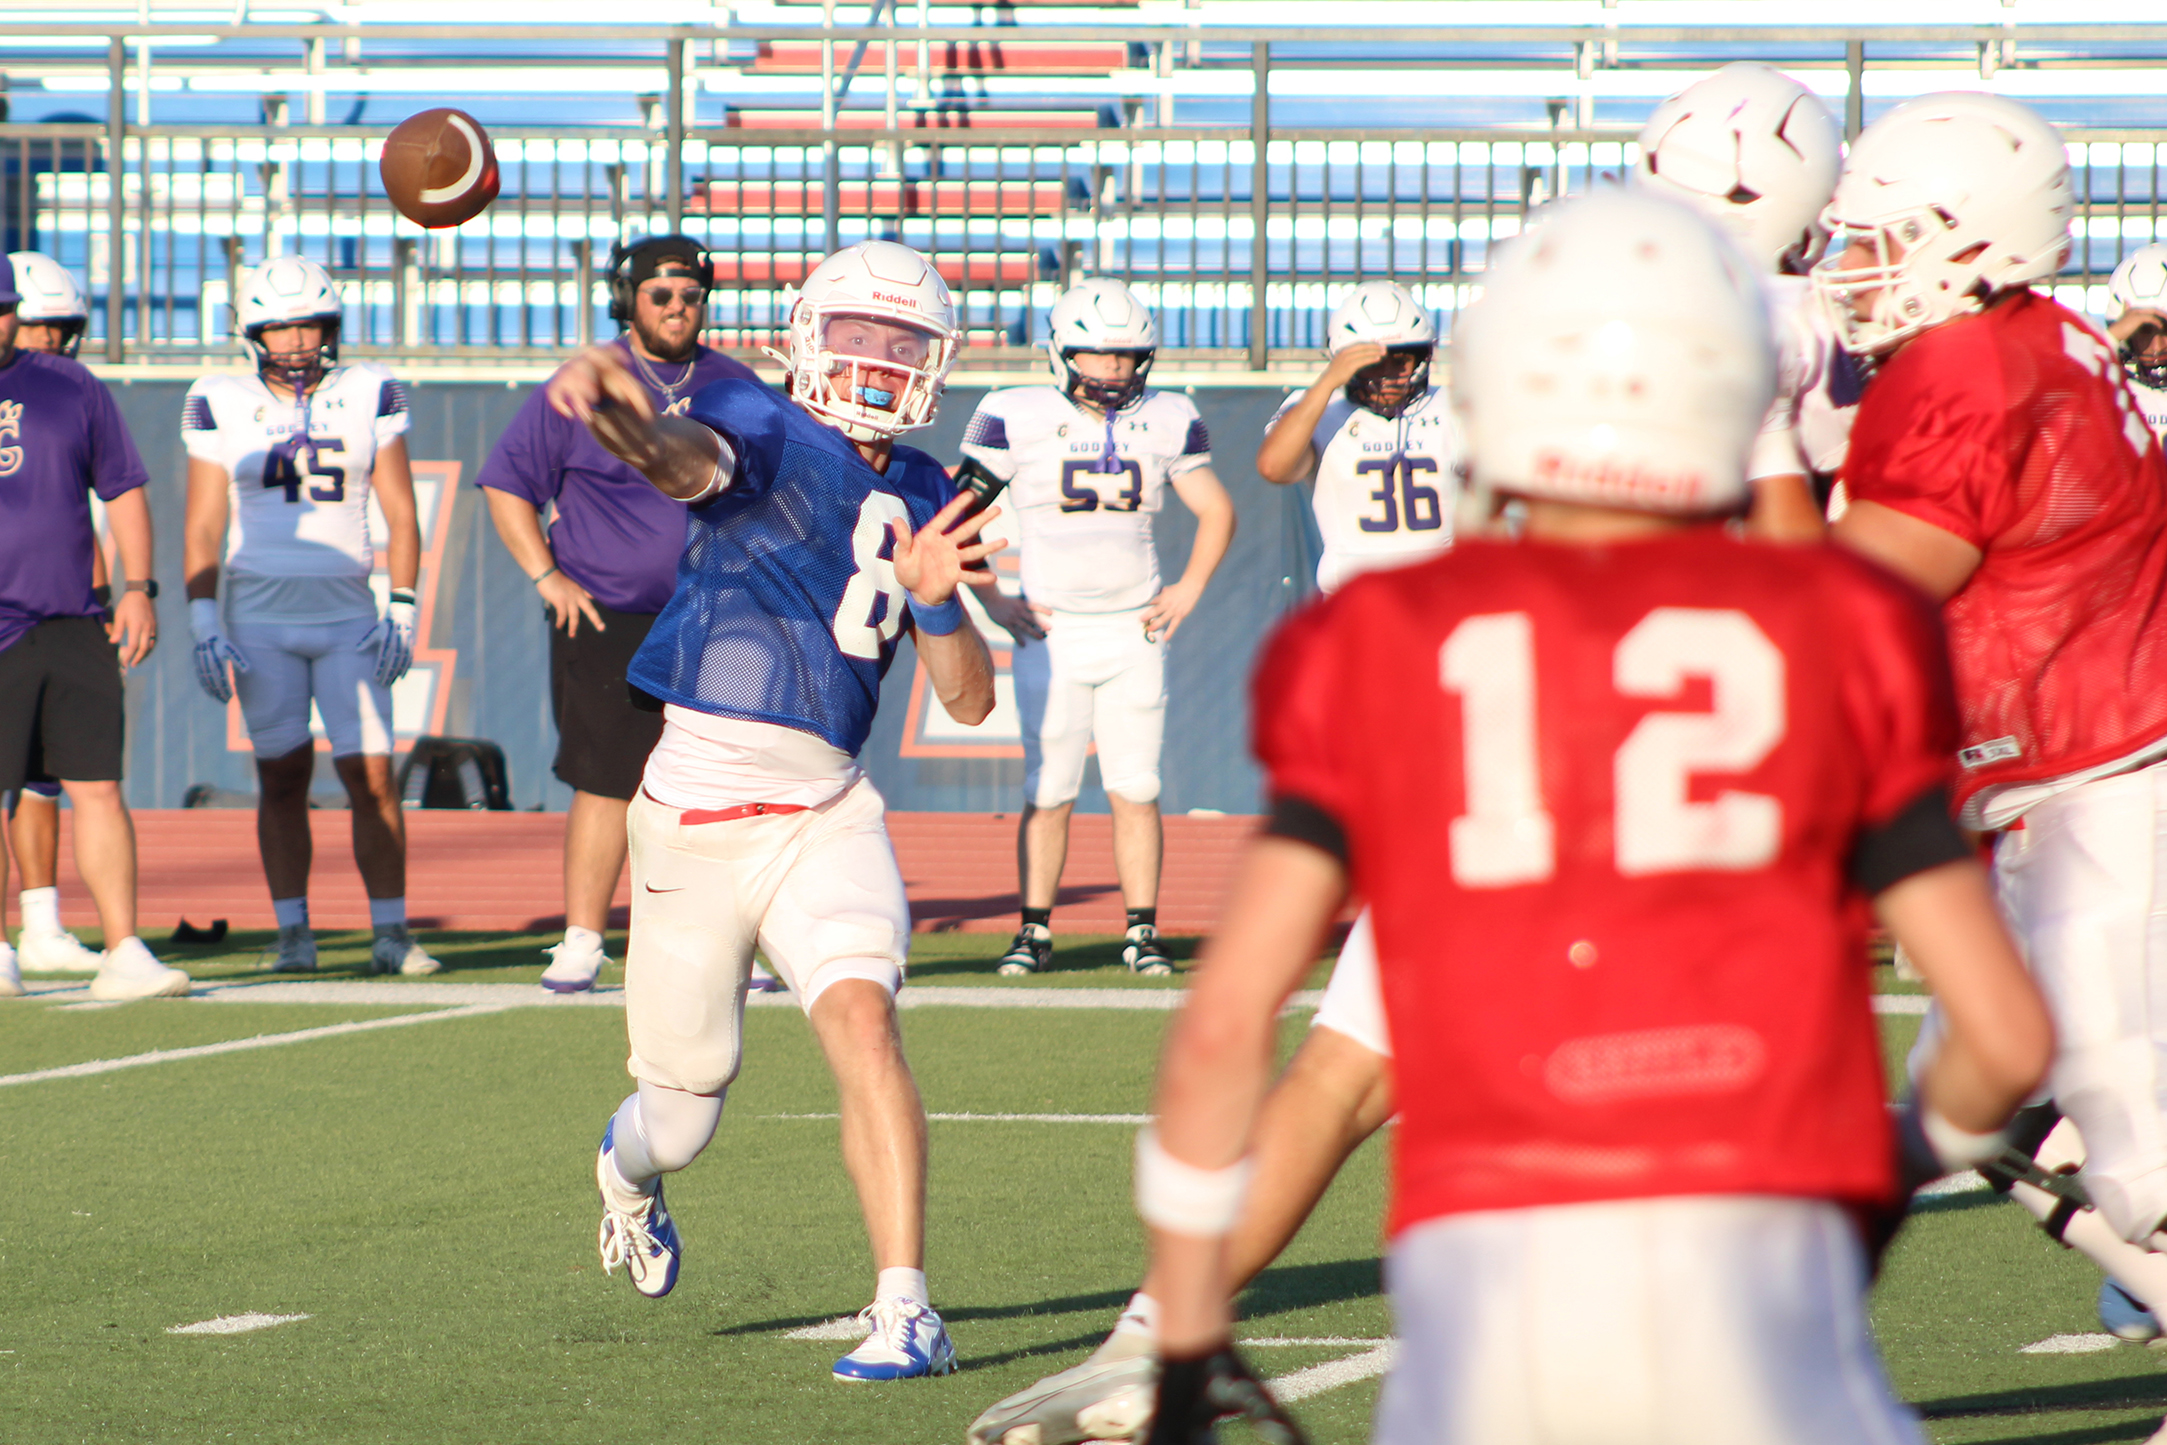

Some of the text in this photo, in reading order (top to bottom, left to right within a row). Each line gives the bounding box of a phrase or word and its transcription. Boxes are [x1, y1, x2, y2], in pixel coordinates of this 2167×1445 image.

[872, 291, 917, 308] Riddell
[266, 422, 329, 436] GODEY
[1362, 440, 1424, 452] GODEY
[263, 438, 346, 503] 45
[1060, 460, 1142, 513] 53
[1355, 456, 1441, 532] 36
[833, 489, 913, 660] 8
[1438, 605, 1788, 891] 12
